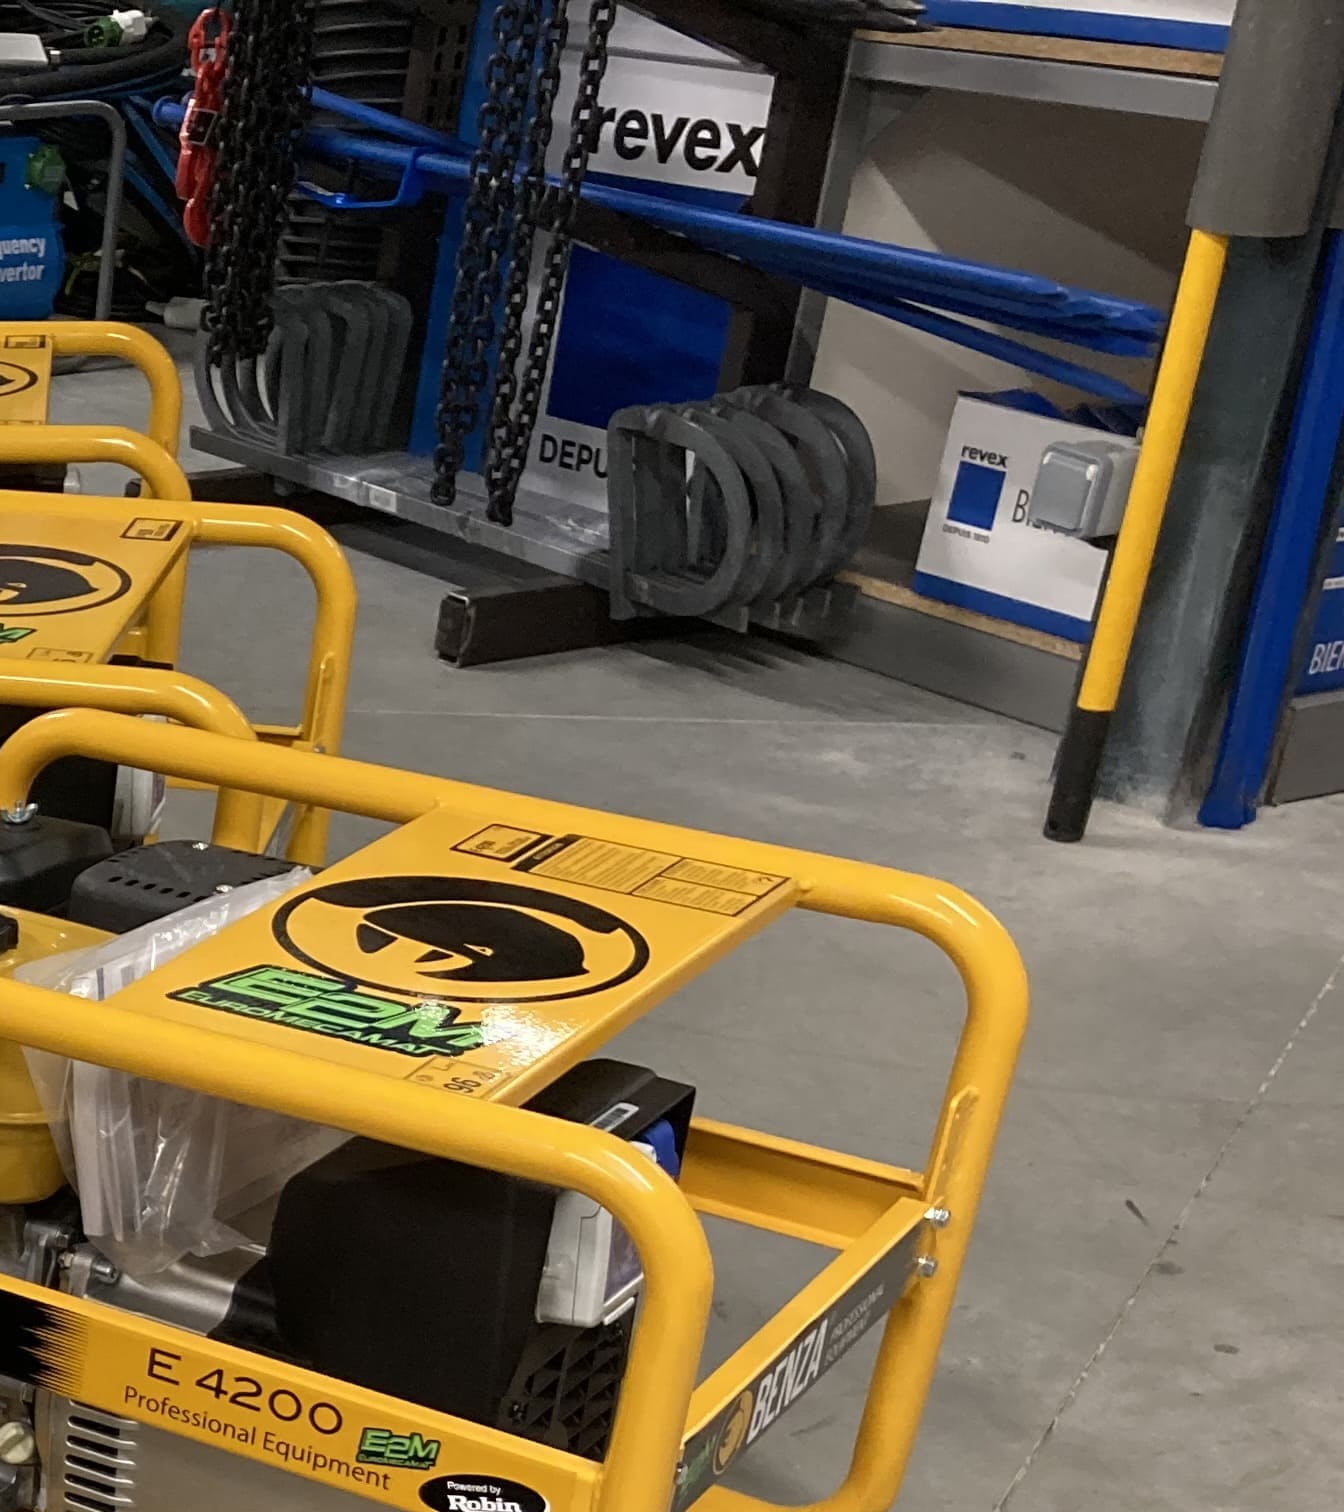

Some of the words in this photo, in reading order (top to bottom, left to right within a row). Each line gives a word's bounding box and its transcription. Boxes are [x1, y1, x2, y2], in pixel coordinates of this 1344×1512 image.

[587, 105, 766, 177] revex
[539, 433, 608, 478] DEPU
[961, 445, 1008, 468] revex
[179, 990, 452, 1055] EUROMECAMAT
[147, 1347, 182, 1387] E
[196, 1368, 343, 1435] 4200
[746, 1318, 828, 1445] BENZA
[125, 1386, 257, 1447] Professional
[262, 1432, 392, 1492] Equipment
[362, 1428, 440, 1463] E2M
[446, 1480, 486, 1495] Powered
[489, 1484, 502, 1496] by
